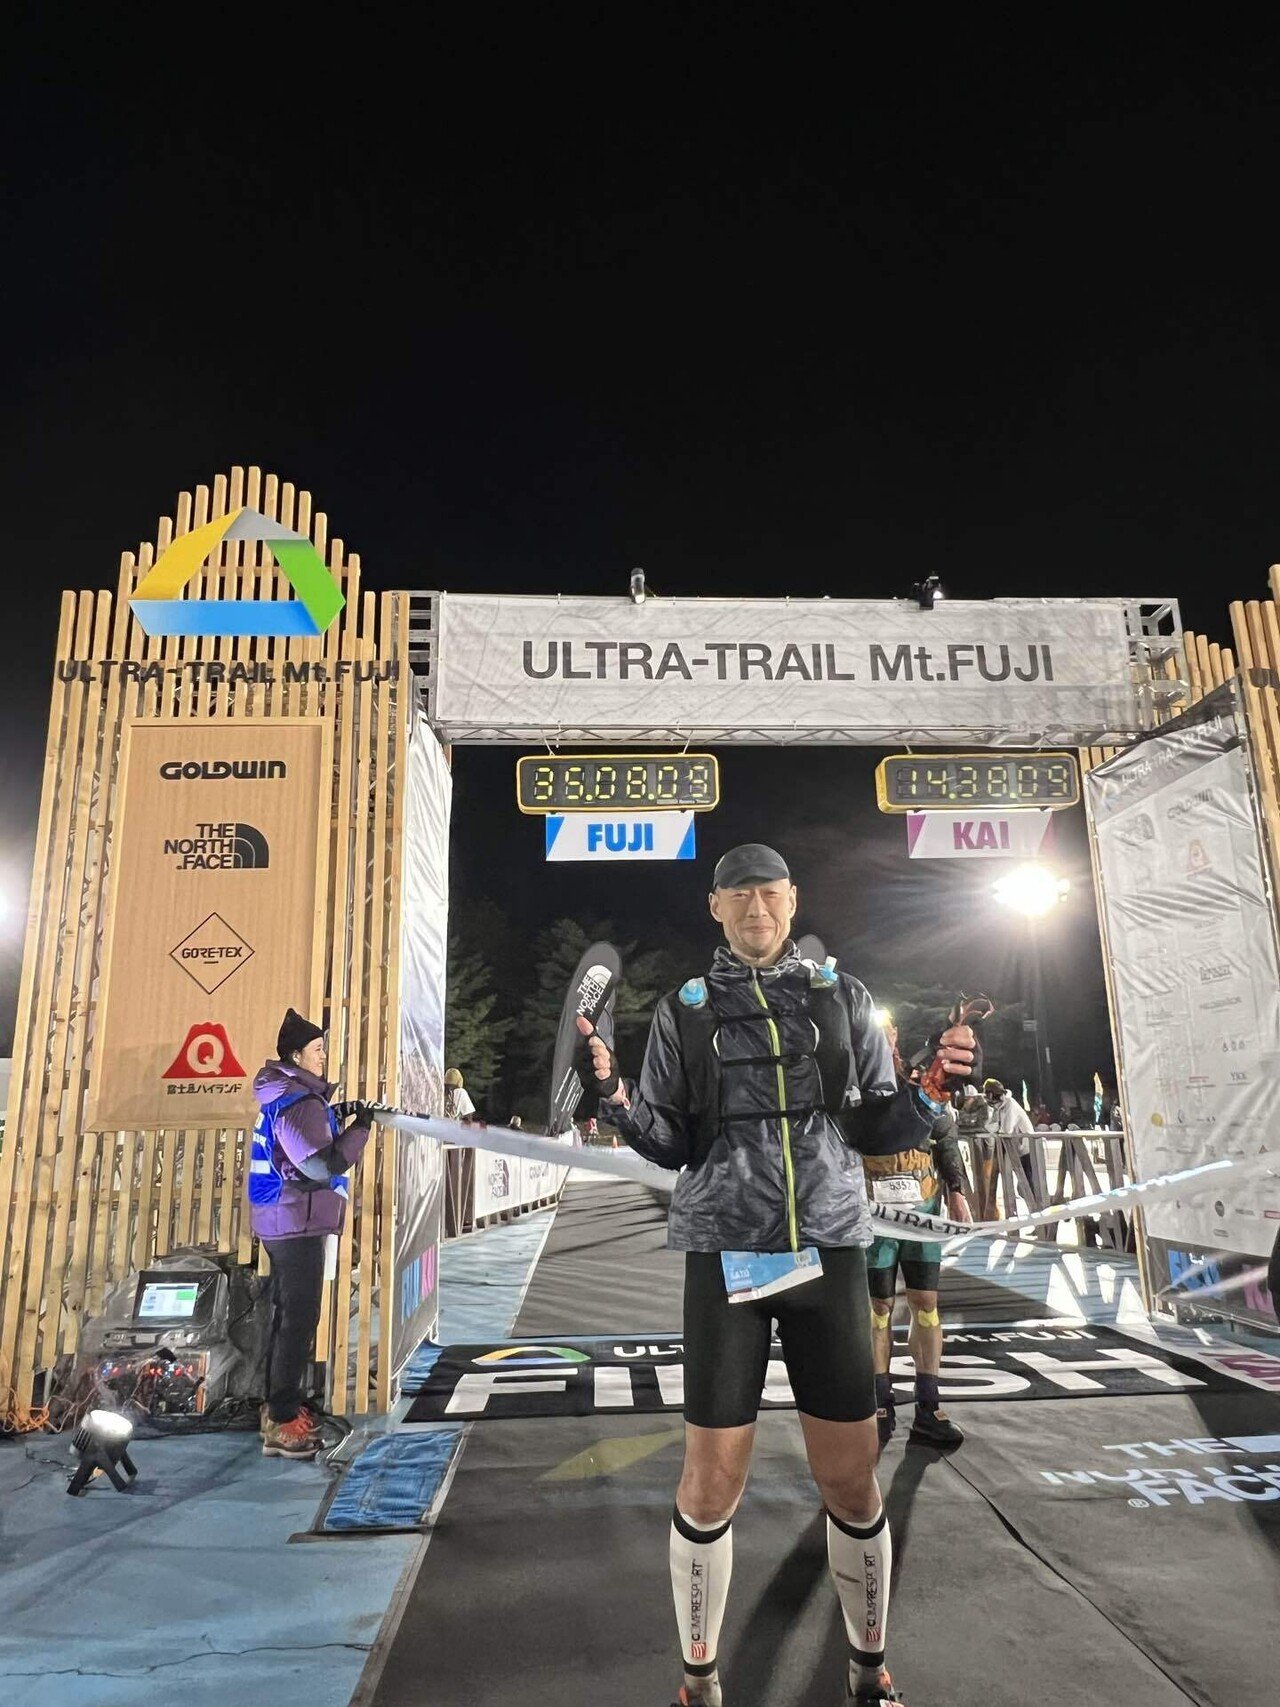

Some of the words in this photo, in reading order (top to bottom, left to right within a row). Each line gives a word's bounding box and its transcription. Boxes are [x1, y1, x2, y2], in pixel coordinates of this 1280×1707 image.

[58, 659, 277, 683] ULTRA-TRAIL
[523, 641, 855, 680] ULTRA-TRAIL
[869, 644, 1054, 682] Mt.FUJI
[160, 761, 286, 780] GOLDWIN
[196, 823, 234, 838] THE
[588, 823, 654, 851] FUJI
[953, 821, 1011, 849] KAI
[164, 839, 233, 854] NORTH
[183, 854, 232, 869] FACE
[182, 947, 243, 959] GORE-TEX
[577, 974, 592, 995] THE
[576, 980, 599, 1016] NORTH
[588, 984, 606, 1012] FACE
[1102, 1437, 1245, 1459] THE
